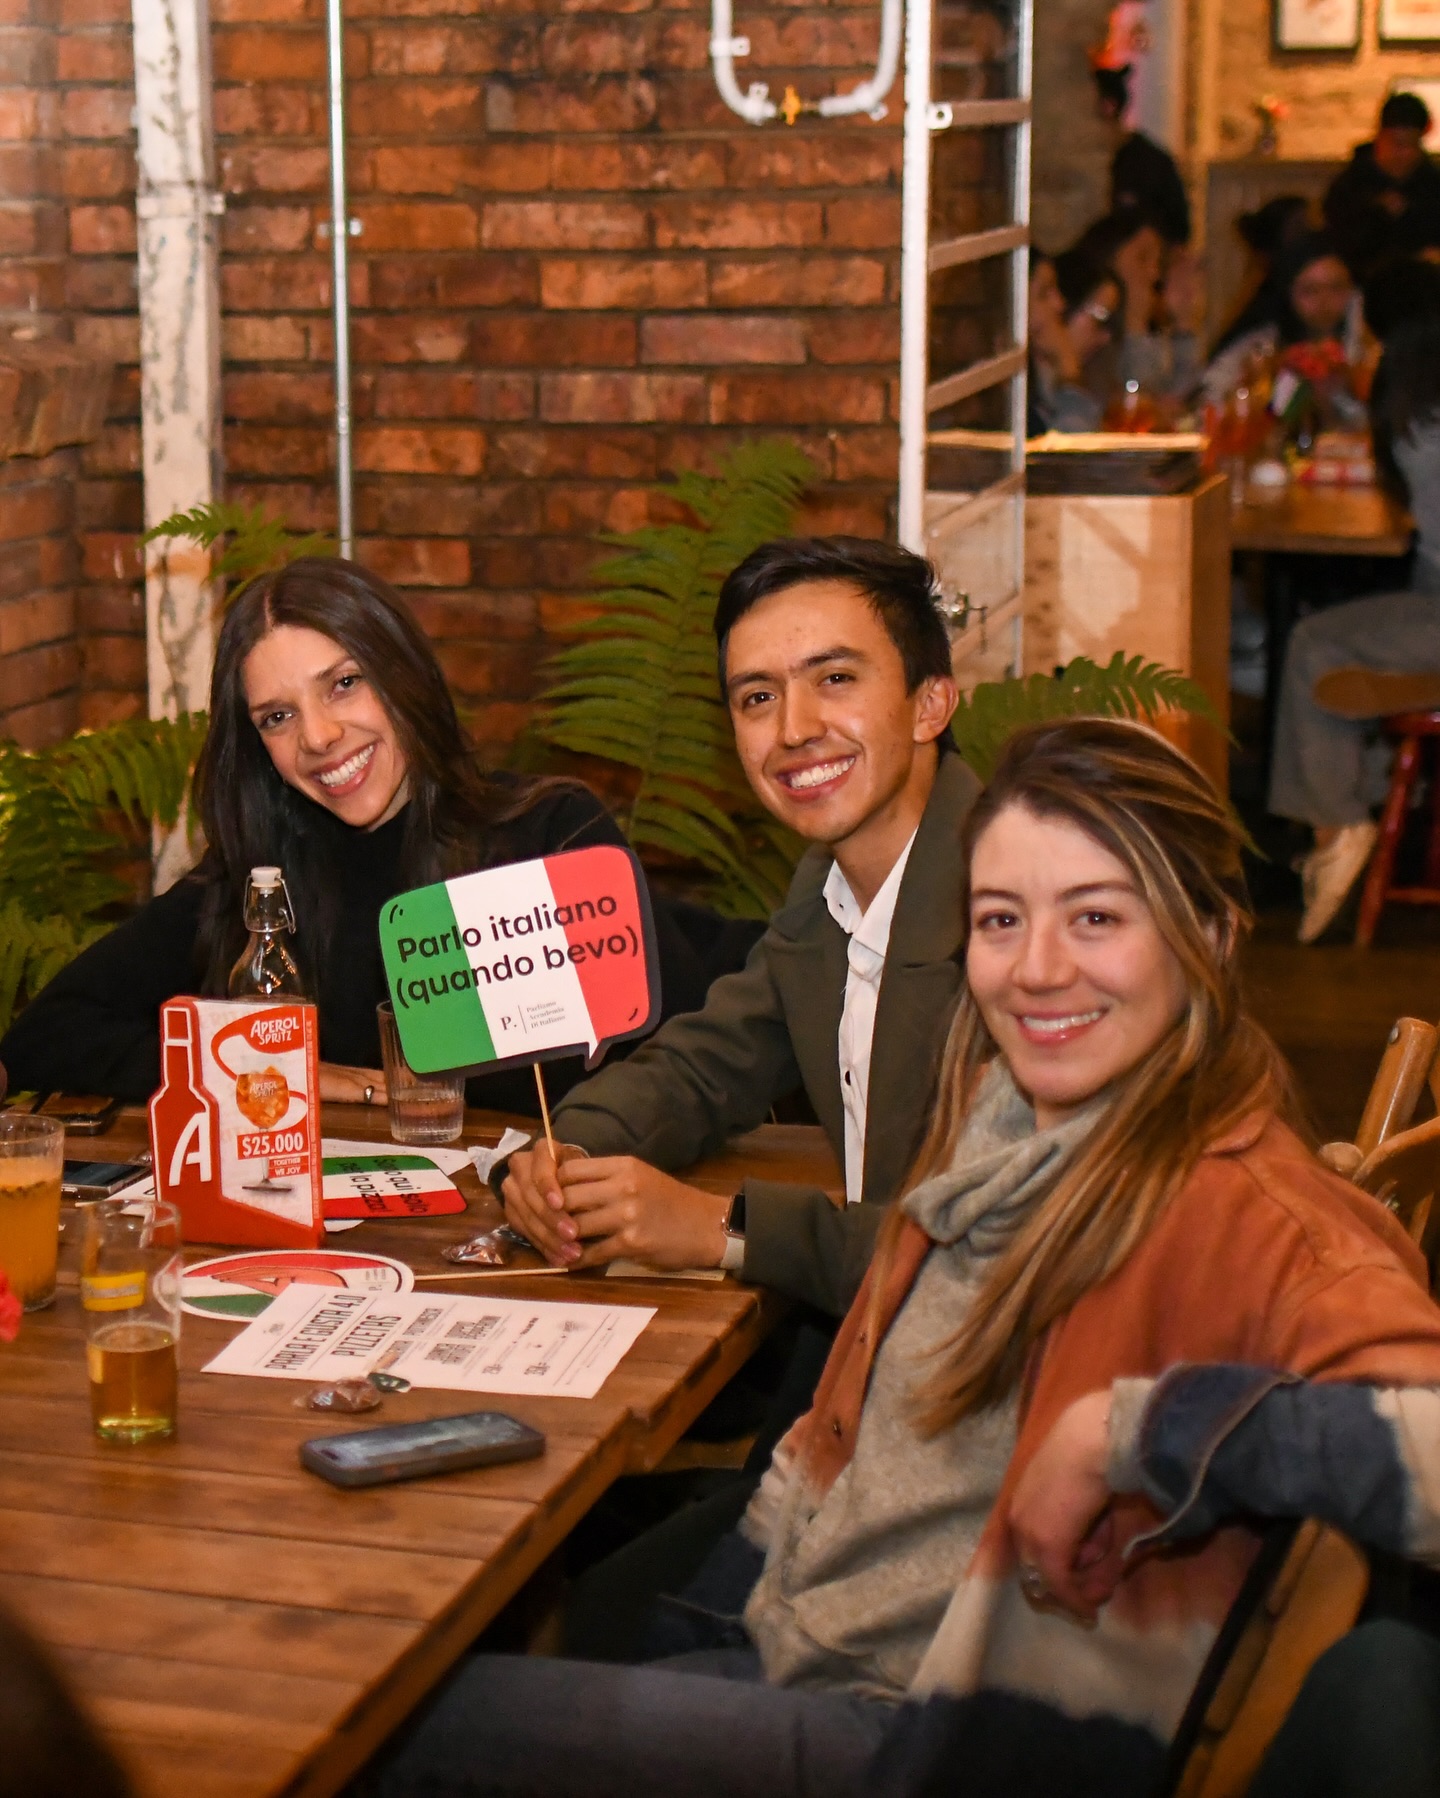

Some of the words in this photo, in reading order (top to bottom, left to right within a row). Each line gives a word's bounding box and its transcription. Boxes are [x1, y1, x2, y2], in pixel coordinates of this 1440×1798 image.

[397, 925, 482, 963] Parlo
[488, 895, 618, 942] italiano
[395, 954, 535, 1009] (quando
[543, 925, 639, 971] bevo)
[250, 1016, 300, 1038] APEROL
[500, 1016, 517, 1031] P.
[258, 1030, 292, 1045] SPRITZ
[242, 1132, 303, 1158] $25.000
[286, 1167, 301, 1176] JOY
[350, 1174, 372, 1182] la
[385, 1177, 421, 1191] qui
[264, 1343, 320, 1371] PARLA
[300, 1309, 353, 1336] GUSTA
[328, 1294, 367, 1308] 4.0
[330, 1315, 402, 1357] PIZZETAS
